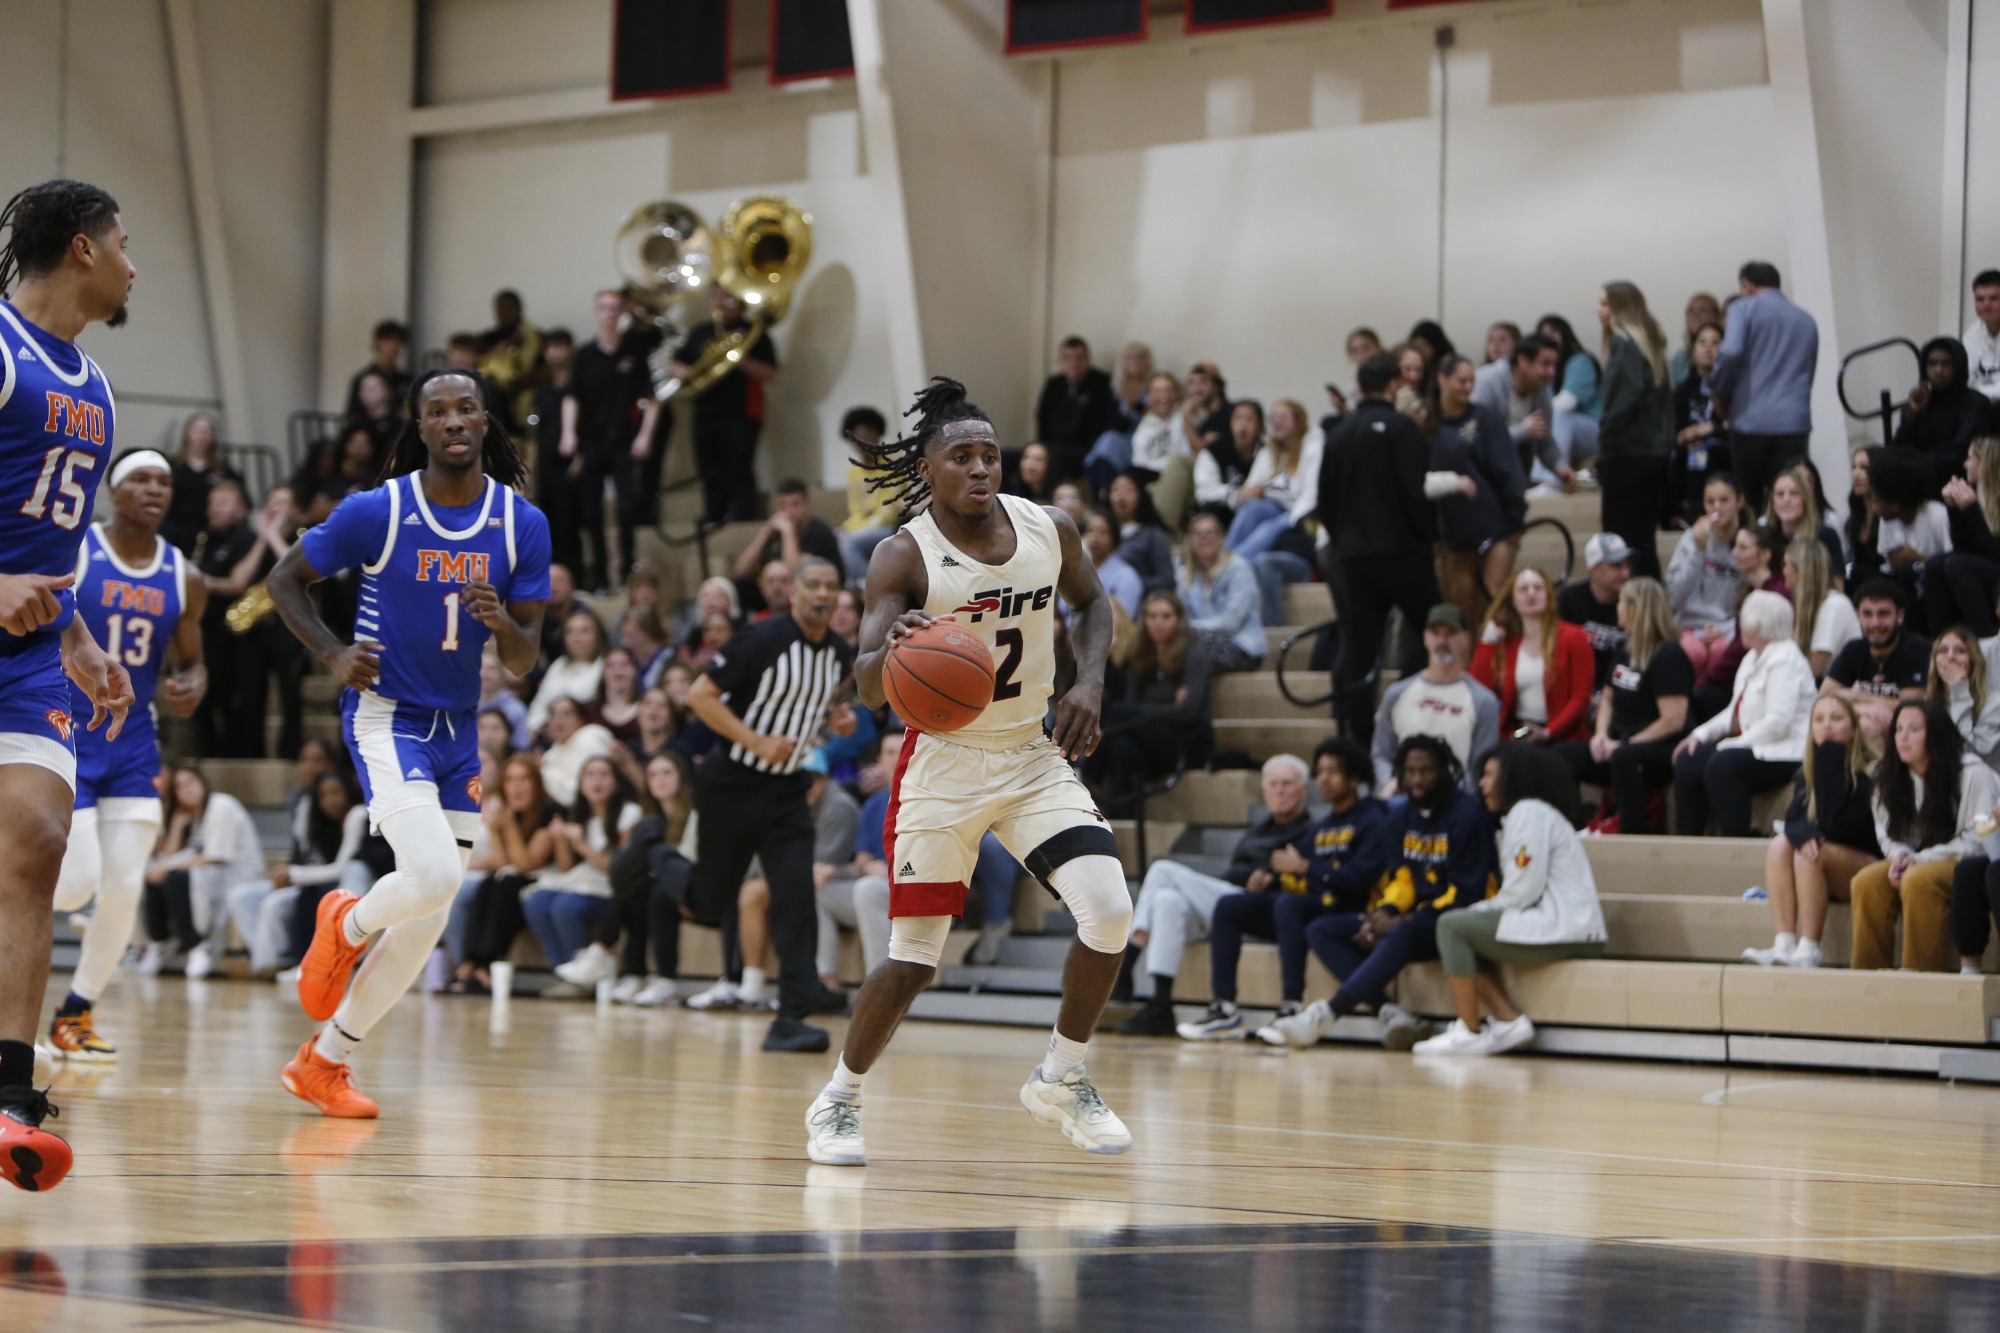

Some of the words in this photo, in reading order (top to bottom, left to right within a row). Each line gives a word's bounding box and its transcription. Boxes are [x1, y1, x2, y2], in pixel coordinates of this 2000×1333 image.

[44, 391, 106, 446] FMU
[19, 445, 97, 531] 15
[416, 549, 490, 584] FMU
[101, 579, 165, 616] FMU
[442, 592, 460, 651] 1
[953, 585, 1053, 623] Fire
[107, 613, 155, 667] 13
[992, 628, 1023, 702] 2
